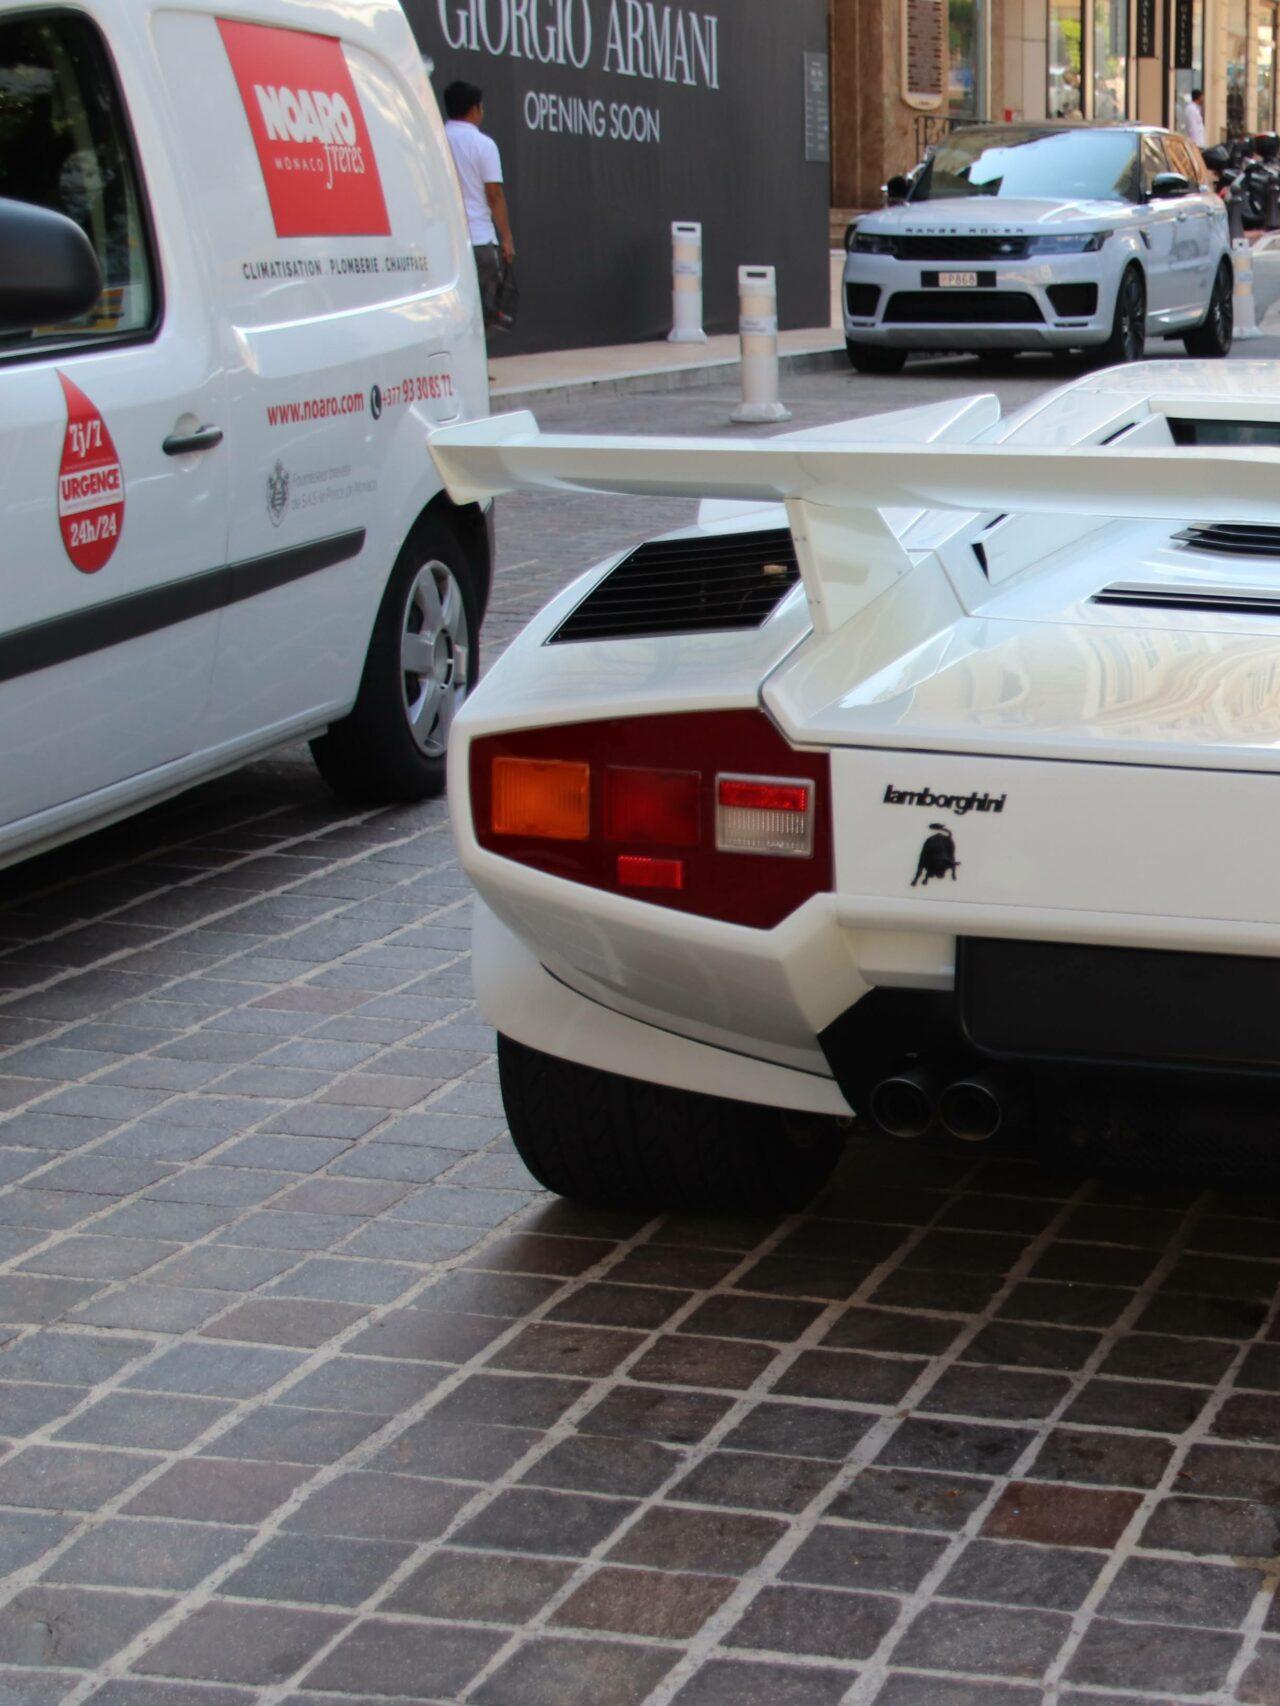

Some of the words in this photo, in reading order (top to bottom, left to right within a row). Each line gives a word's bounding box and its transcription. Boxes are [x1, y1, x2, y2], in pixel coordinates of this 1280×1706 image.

[437, 0, 592, 69] GIORGIO
[602, 0, 720, 89] ARMANI
[254, 84, 357, 146] NOARO
[523, 90, 606, 138] OPENING
[609, 102, 661, 143] SOON
[275, 156, 323, 171] MONACO
[242, 260, 322, 280] CLIMATISATION
[331, 258, 379, 275] PLOMBERIE
[385, 256, 429, 272] CHAUFFAGE
[402, 378, 415, 403] 93
[416, 376, 429, 400] 30
[267, 392, 364, 426] www.noaro.com
[69, 420, 102, 458] 7j/7
[61, 467, 120, 502] URGENCE
[70, 512, 117, 548] 24h/24
[883, 784, 1007, 815] lamborghini
